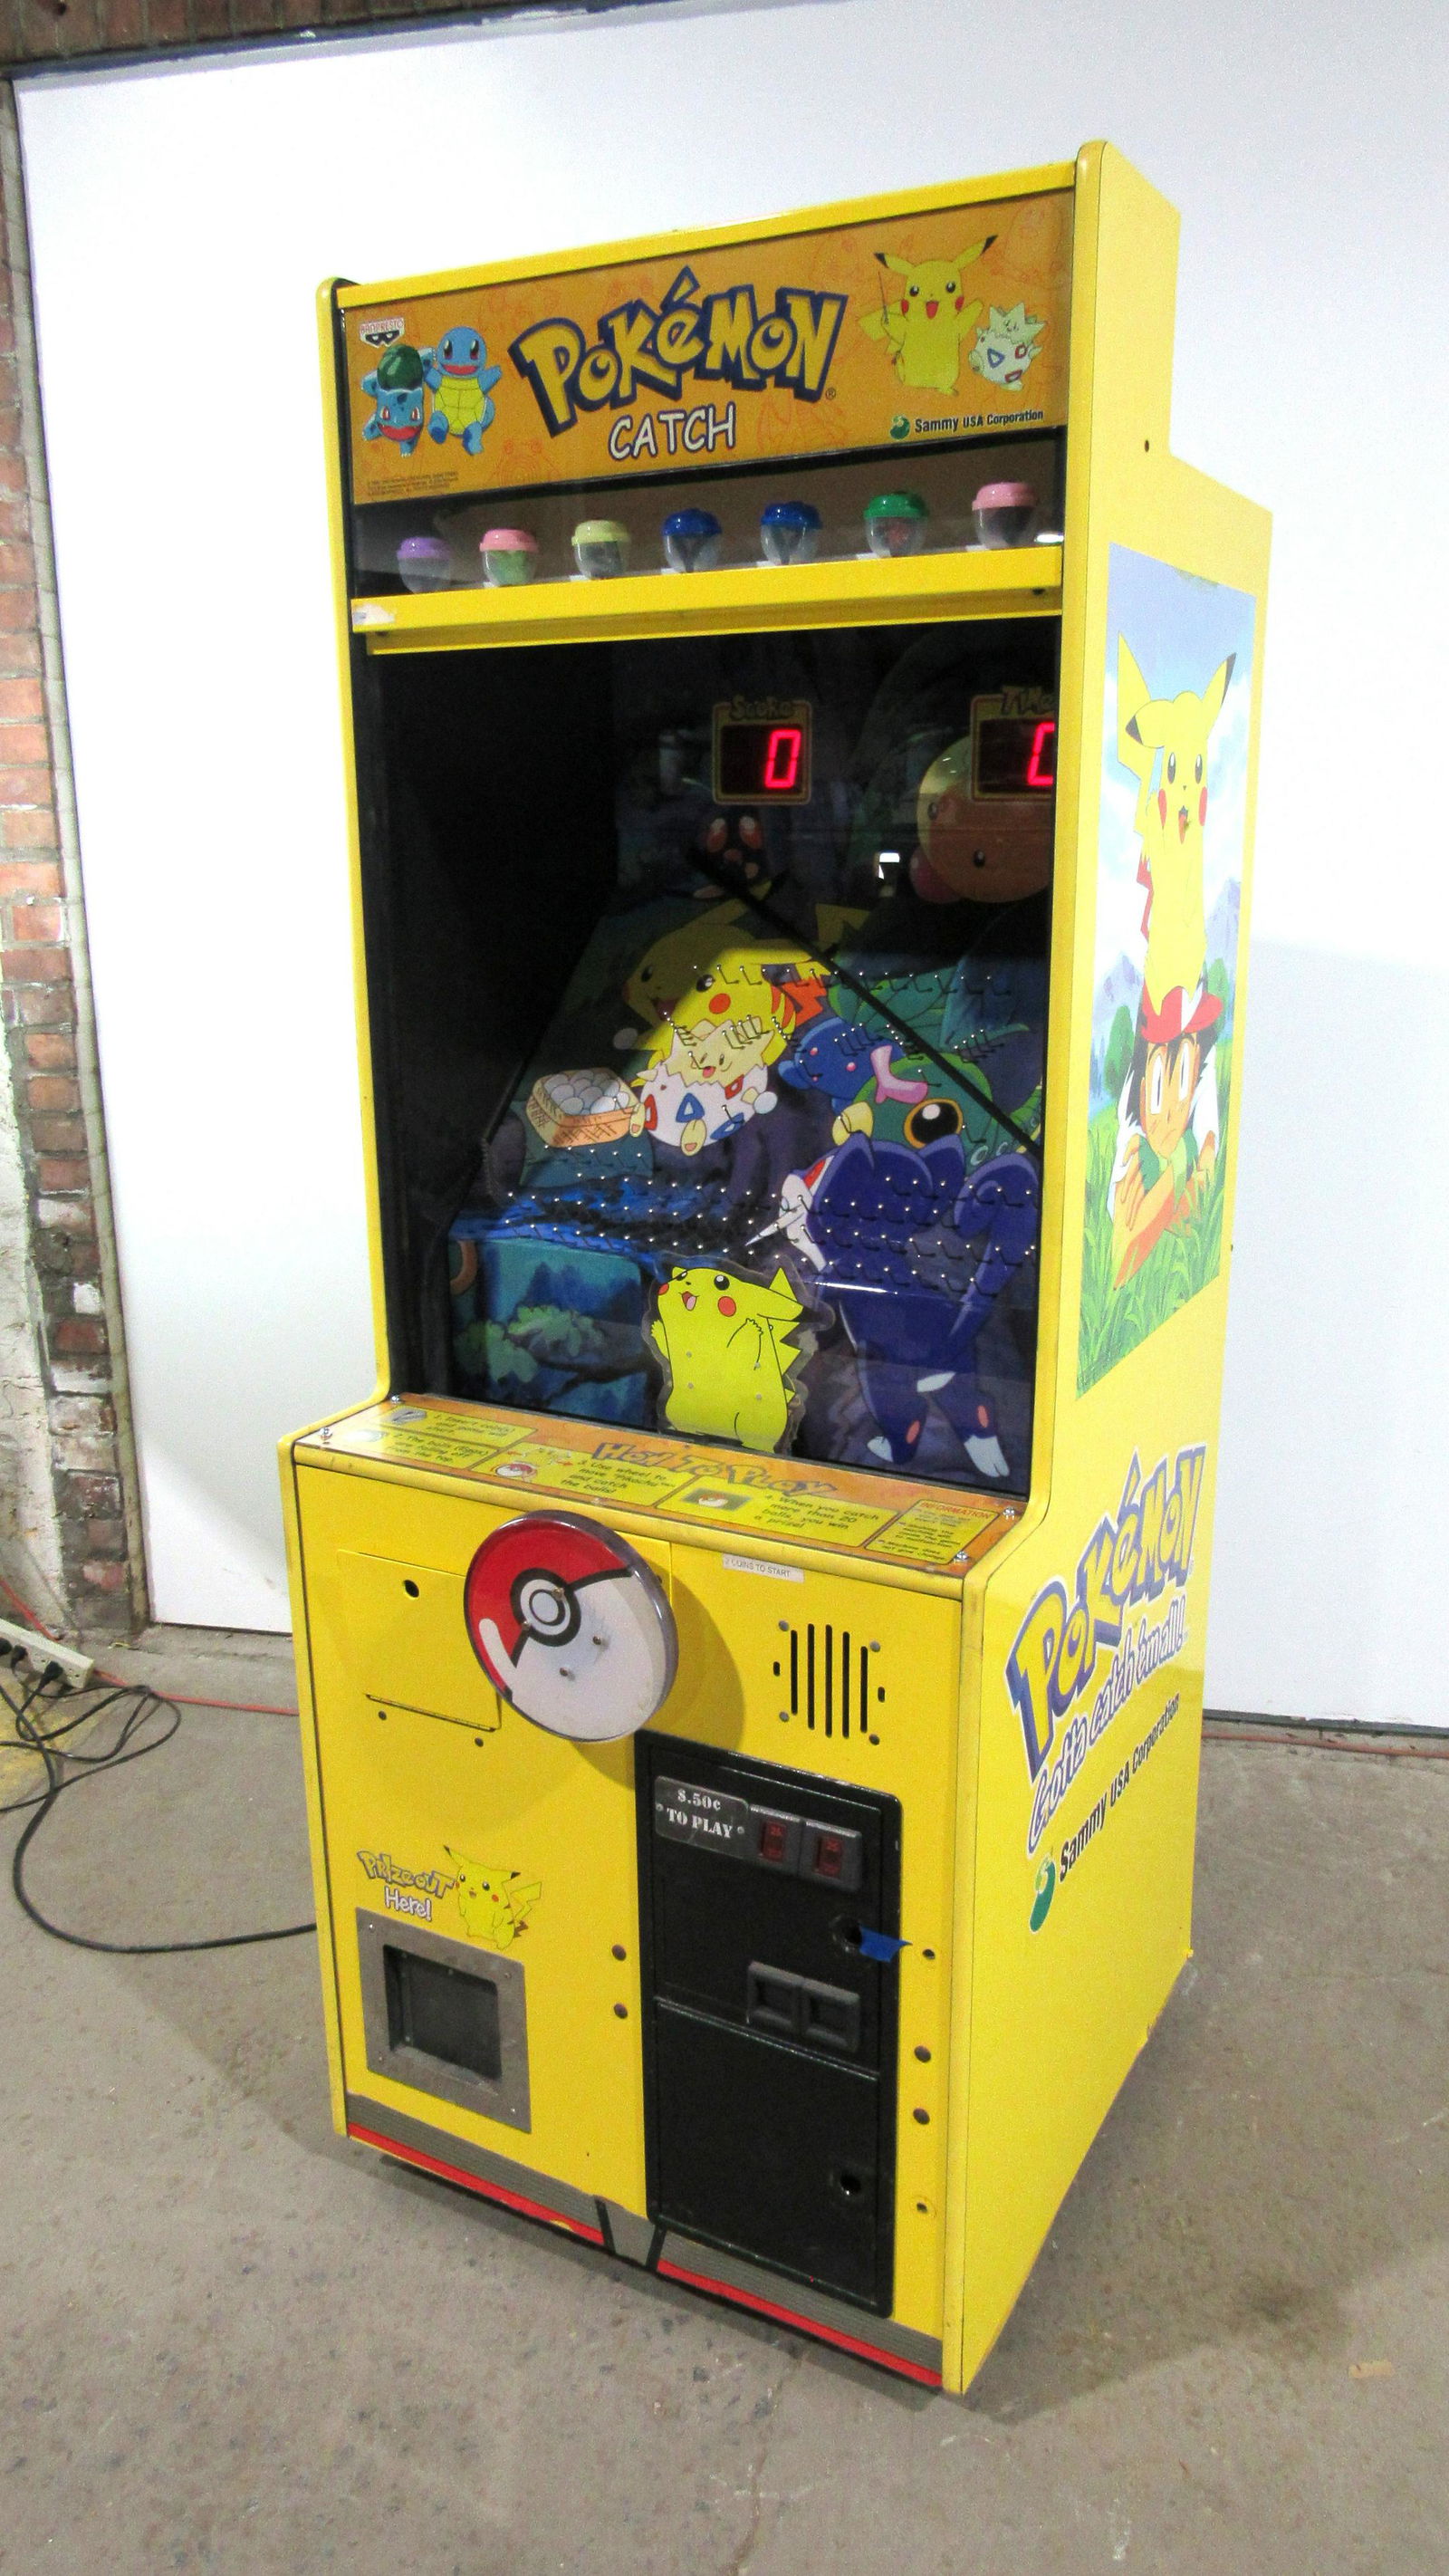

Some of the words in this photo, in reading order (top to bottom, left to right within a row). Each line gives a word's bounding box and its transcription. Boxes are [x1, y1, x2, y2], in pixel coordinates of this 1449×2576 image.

[608, 401, 735, 460] CATCH
[915, 417, 959, 433] Sammy
[963, 414, 984, 428] USA
[987, 409, 1043, 425] Corporation
[764, 729, 801, 789] 0
[580, 1468, 607, 1477] move
[617, 1467, 652, 1477] wheel
[561, 1479, 581, 1487] the
[593, 1479, 628, 1489] catch
[770, 1504, 801, 1514] more
[806, 1509, 834, 1520] than
[779, 1496, 813, 1509] When
[818, 1506, 840, 1514] you
[843, 1509, 879, 1521] catch
[920, 1503, 992, 1520] INFORMATION
[801, 1517, 823, 1525] you
[755, 1563, 766, 1572] TO
[767, 1567, 791, 1578] START
[1028, 1715, 1087, 1854] Gotta
[1089, 1628, 1136, 1747] catch
[1060, 1791, 1108, 1882] Sammy
[1109, 1761, 1130, 1809] USA
[1132, 1693, 1181, 1775] Corporation
[667, 1807, 688, 1826] TO
[692, 1814, 733, 1839] PLAY
[384, 1885, 432, 1922] Here!
